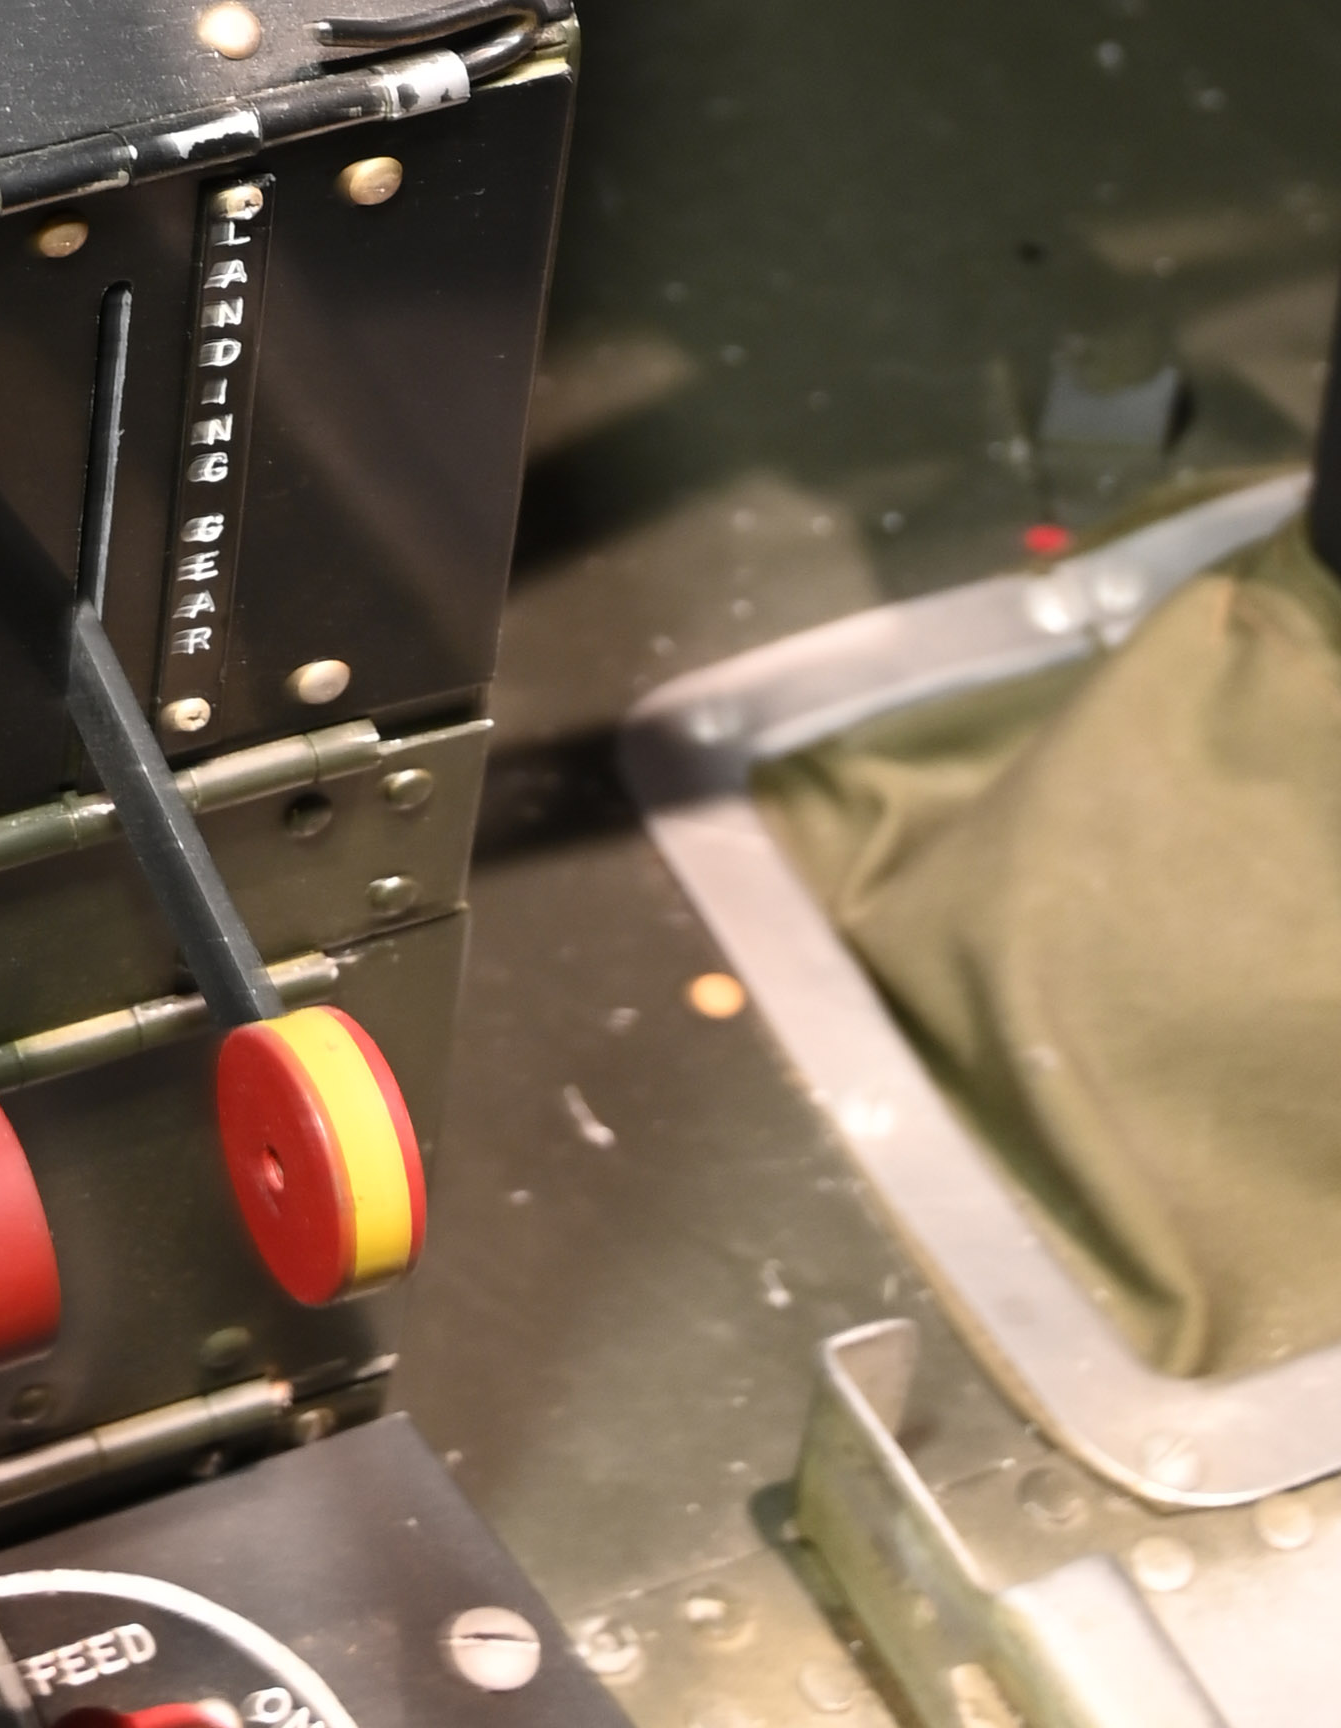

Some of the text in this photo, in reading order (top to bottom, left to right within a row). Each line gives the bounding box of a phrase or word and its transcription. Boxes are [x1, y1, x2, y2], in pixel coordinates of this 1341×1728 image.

[173, 219, 250, 655] LANDING GEAR
[21, 1623, 157, 1696] FEED
